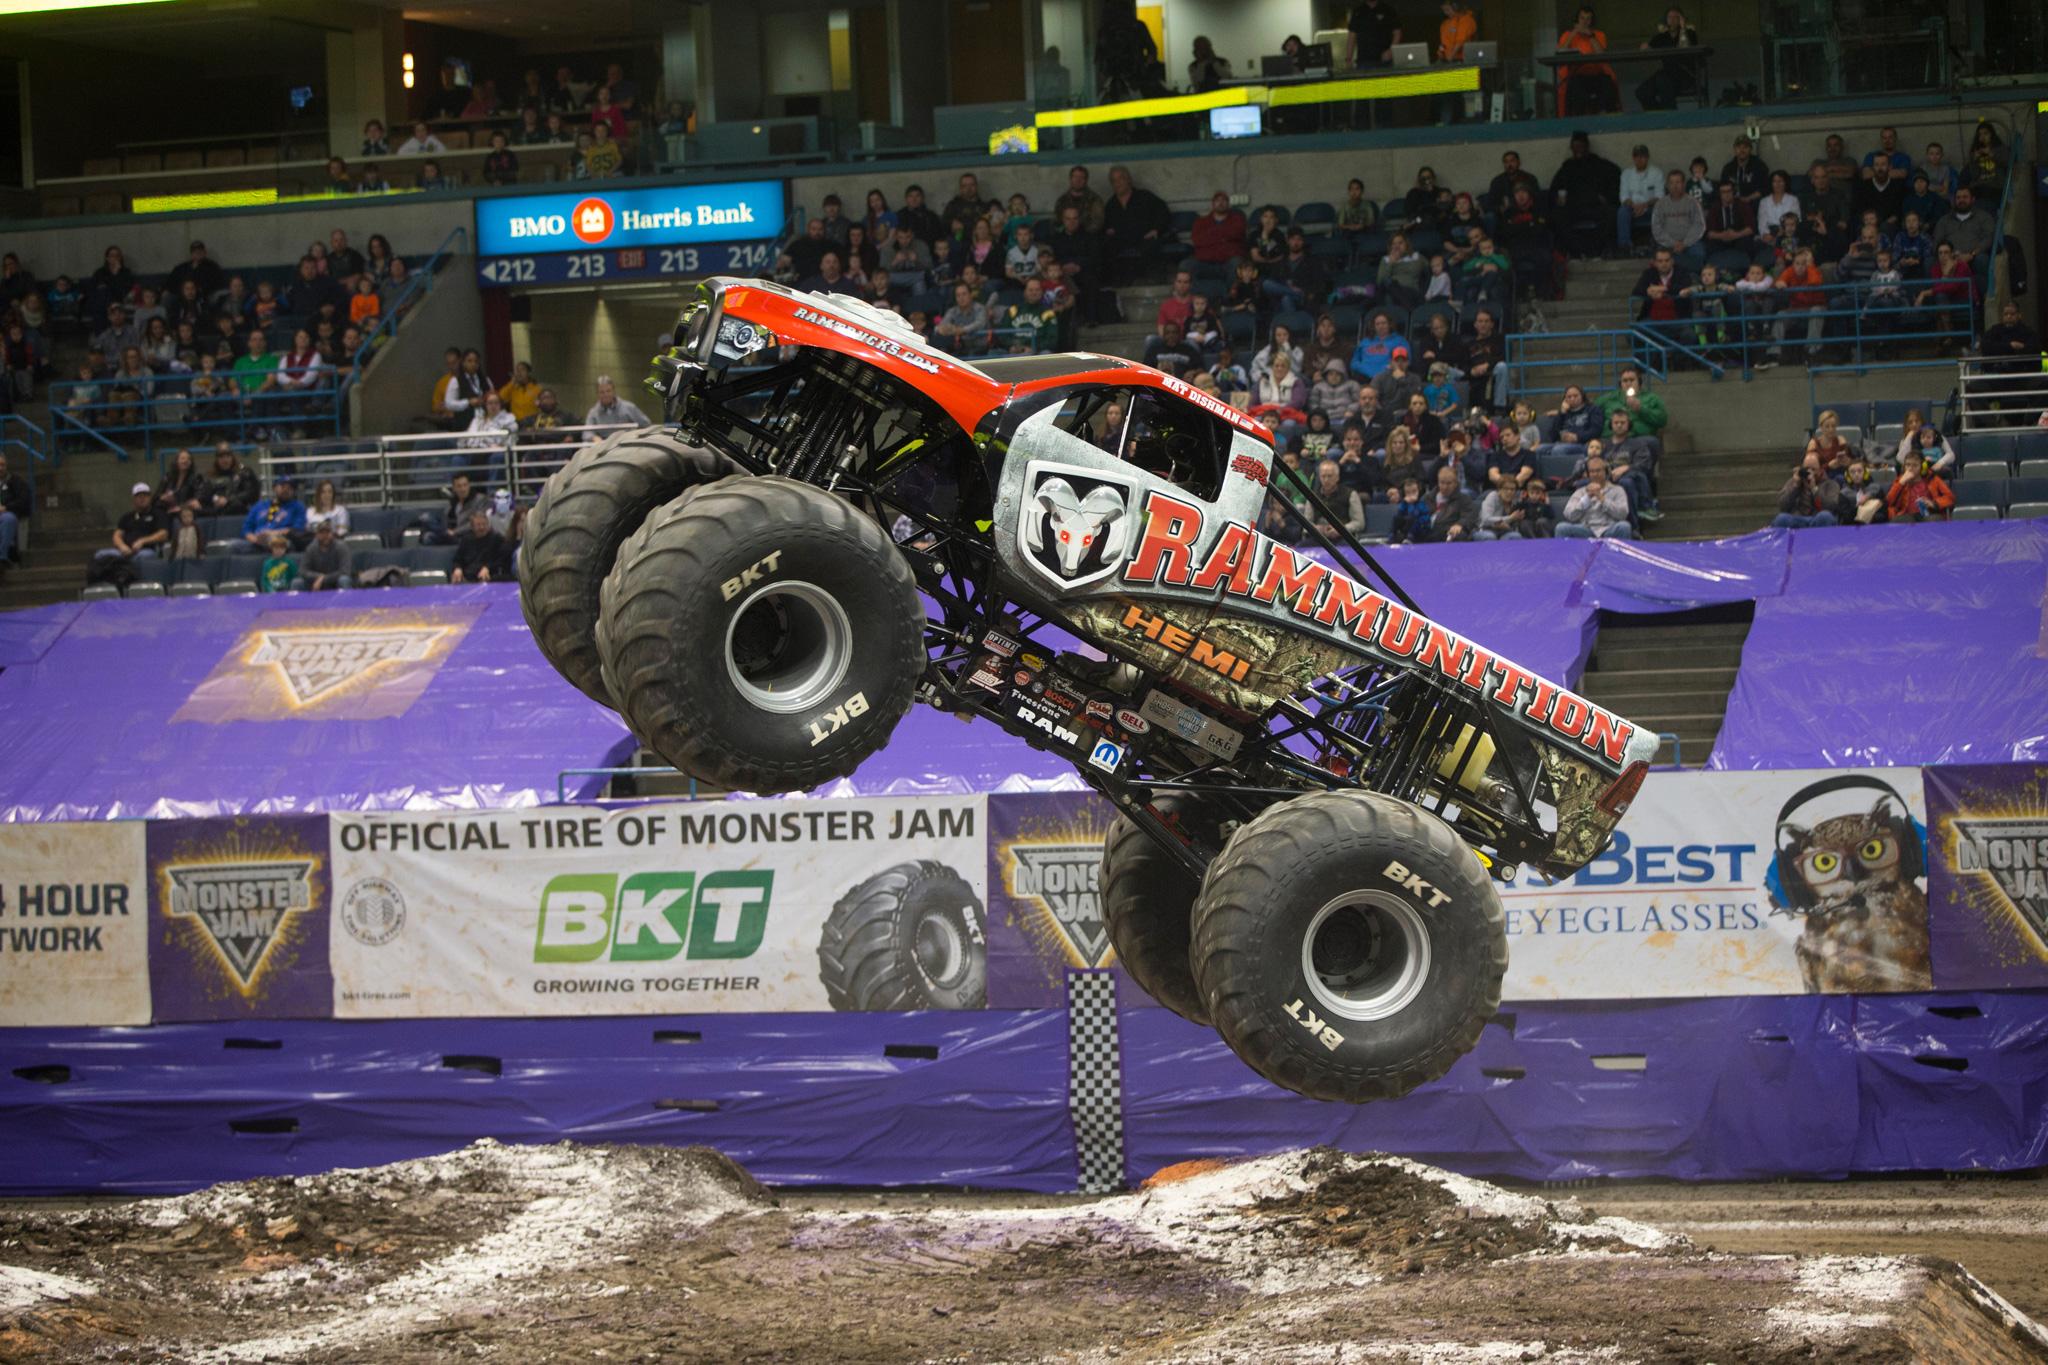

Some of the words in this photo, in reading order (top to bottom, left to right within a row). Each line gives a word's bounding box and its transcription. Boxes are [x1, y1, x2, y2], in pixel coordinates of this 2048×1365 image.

[509, 215, 566, 238] BMO
[622, 207, 692, 231] Harris
[697, 202, 755, 225] Bank
[498, 259, 536, 281] 212
[567, 255, 606, 278] 213
[660, 249, 699, 272] 213
[728, 244, 767, 268] 214
[793, 306, 941, 374] RAMTRUCKS.COM
[1161, 376, 1188, 396] MAT
[1188, 391, 1241, 425] DISHMAN
[719, 549, 783, 602] BKT
[1122, 604, 1252, 684] HEMI
[1123, 489, 1636, 765] RAMMUNITION
[1011, 688, 1061, 719] Firestone
[1044, 689, 1077, 710] BOSCH
[810, 691, 870, 747] BKT
[1016, 706, 1079, 746] RAM
[1120, 711, 1145, 731] BELL
[340, 821, 510, 851] OFFICIAL
[521, 817, 602, 848] TIRE
[617, 815, 666, 847] OF
[680, 810, 875, 845] MONSTER
[888, 807, 975, 840] JAM
[19, 884, 130, 917] HOUR
[172, 879, 309, 913] MONSTER
[1382, 860, 1452, 908] BKT
[210, 909, 275, 939] JAM
[538, 881, 769, 953] BKT
[962, 905, 985, 946] BKT
[1505, 903, 1758, 936] EYEGLASSES
[533, 977, 635, 994] GROWING
[642, 976, 760, 992] TOGETHER
[1281, 998, 1345, 1051] BKT
